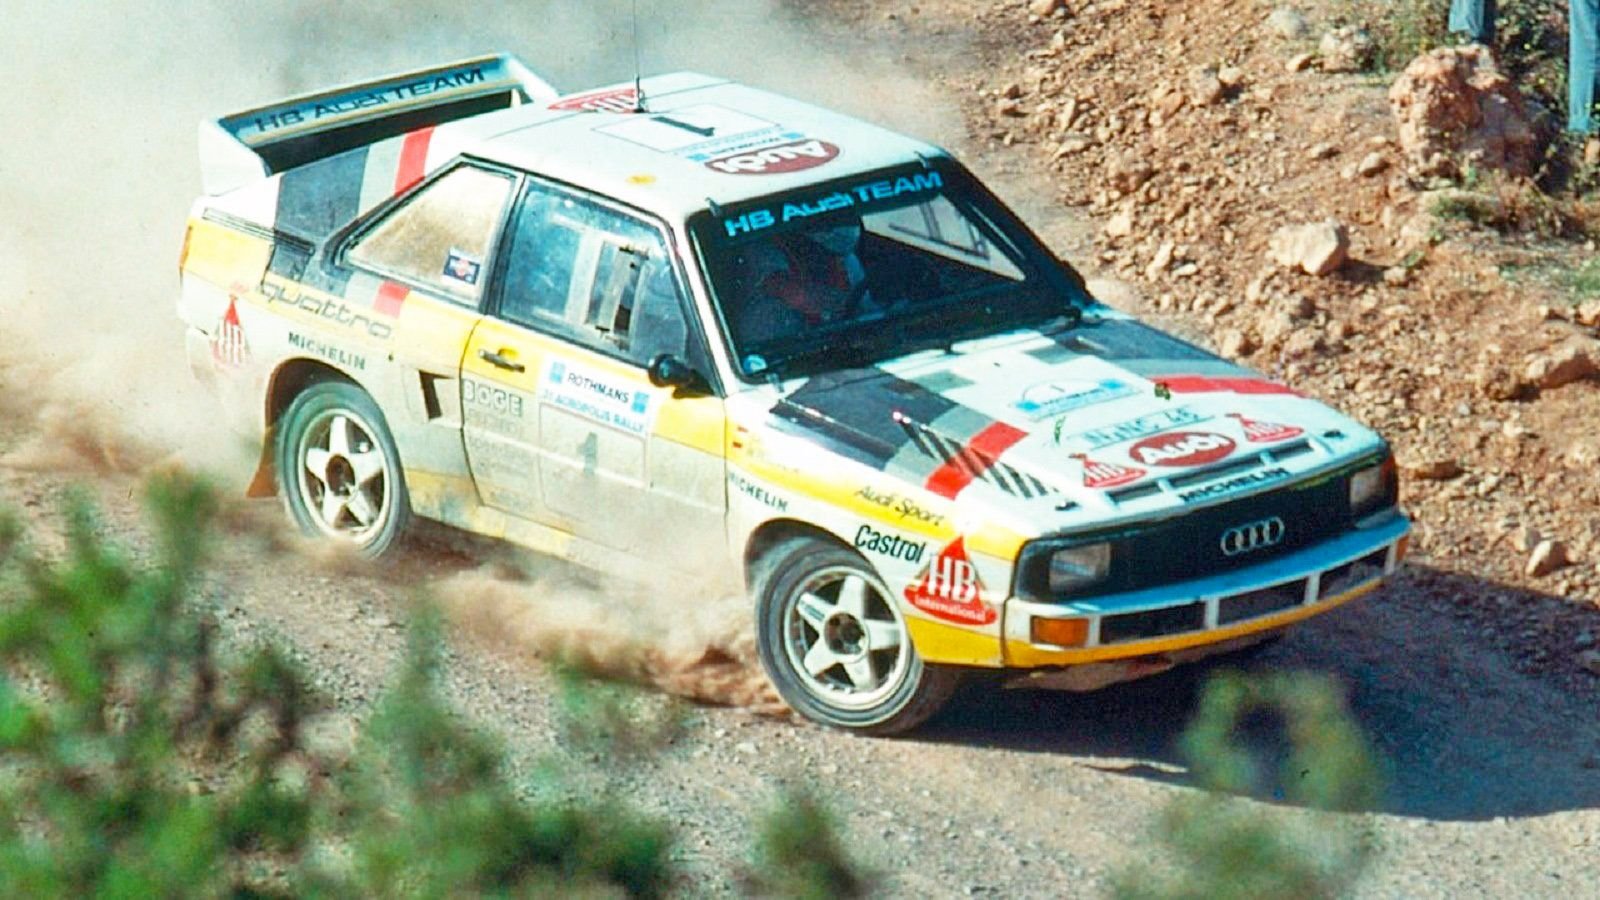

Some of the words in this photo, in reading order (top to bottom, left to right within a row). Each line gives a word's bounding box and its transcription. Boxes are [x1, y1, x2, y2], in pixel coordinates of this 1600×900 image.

[253, 109, 304, 133] HB
[391, 68, 485, 98] TEAM
[650, 115, 715, 137] 1
[725, 209, 774, 236] HB
[855, 171, 942, 203] TEAM
[256, 282, 393, 340] quattro
[287, 331, 366, 371] MICHELIN
[567, 371, 630, 405] ROTHMANS
[576, 430, 599, 477] 1
[1139, 433, 1232, 464] Audi
[1179, 467, 1290, 501] MICHELIN
[854, 484, 892, 507] Audi
[893, 498, 946, 528] Sport
[853, 523, 926, 565] Castrol
[927, 553, 976, 601] HB
